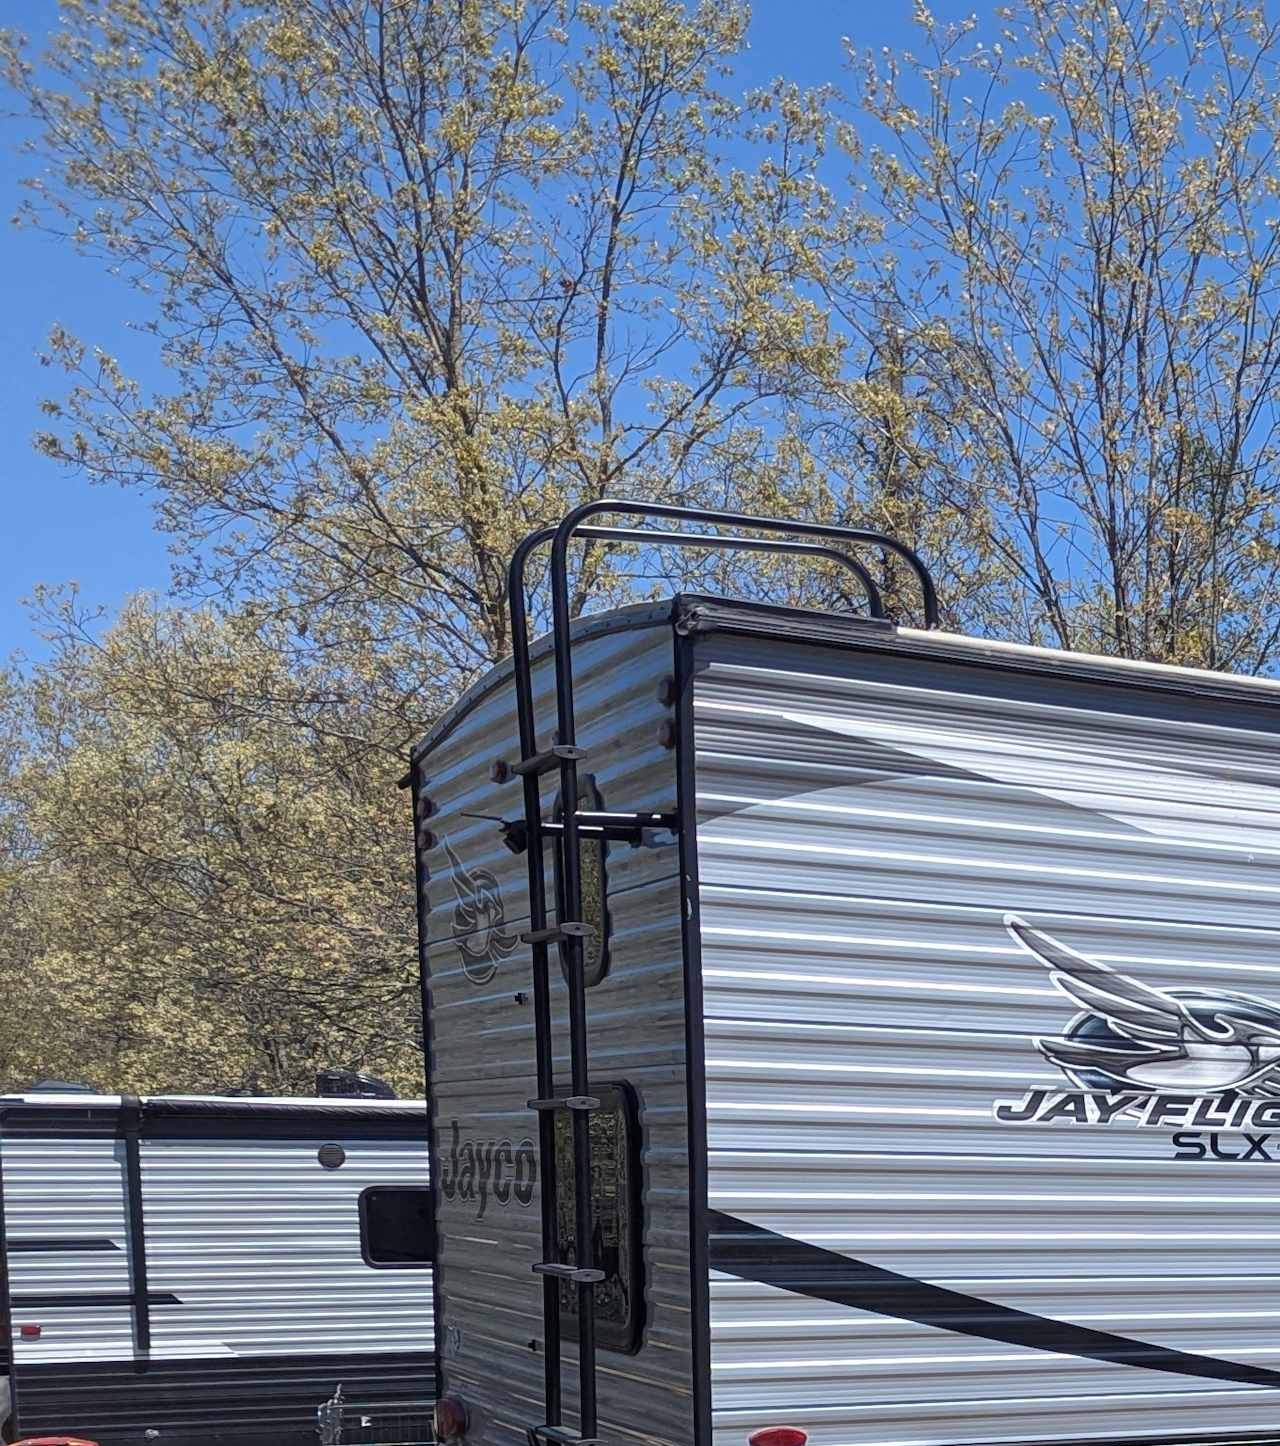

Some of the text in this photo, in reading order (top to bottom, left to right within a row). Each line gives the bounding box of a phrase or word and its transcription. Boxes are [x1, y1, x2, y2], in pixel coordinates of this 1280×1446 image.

[996, 1087, 1138, 1125] JAY
[1172, 1131, 1272, 1161] SLX
[441, 1118, 537, 1220] Jayco
